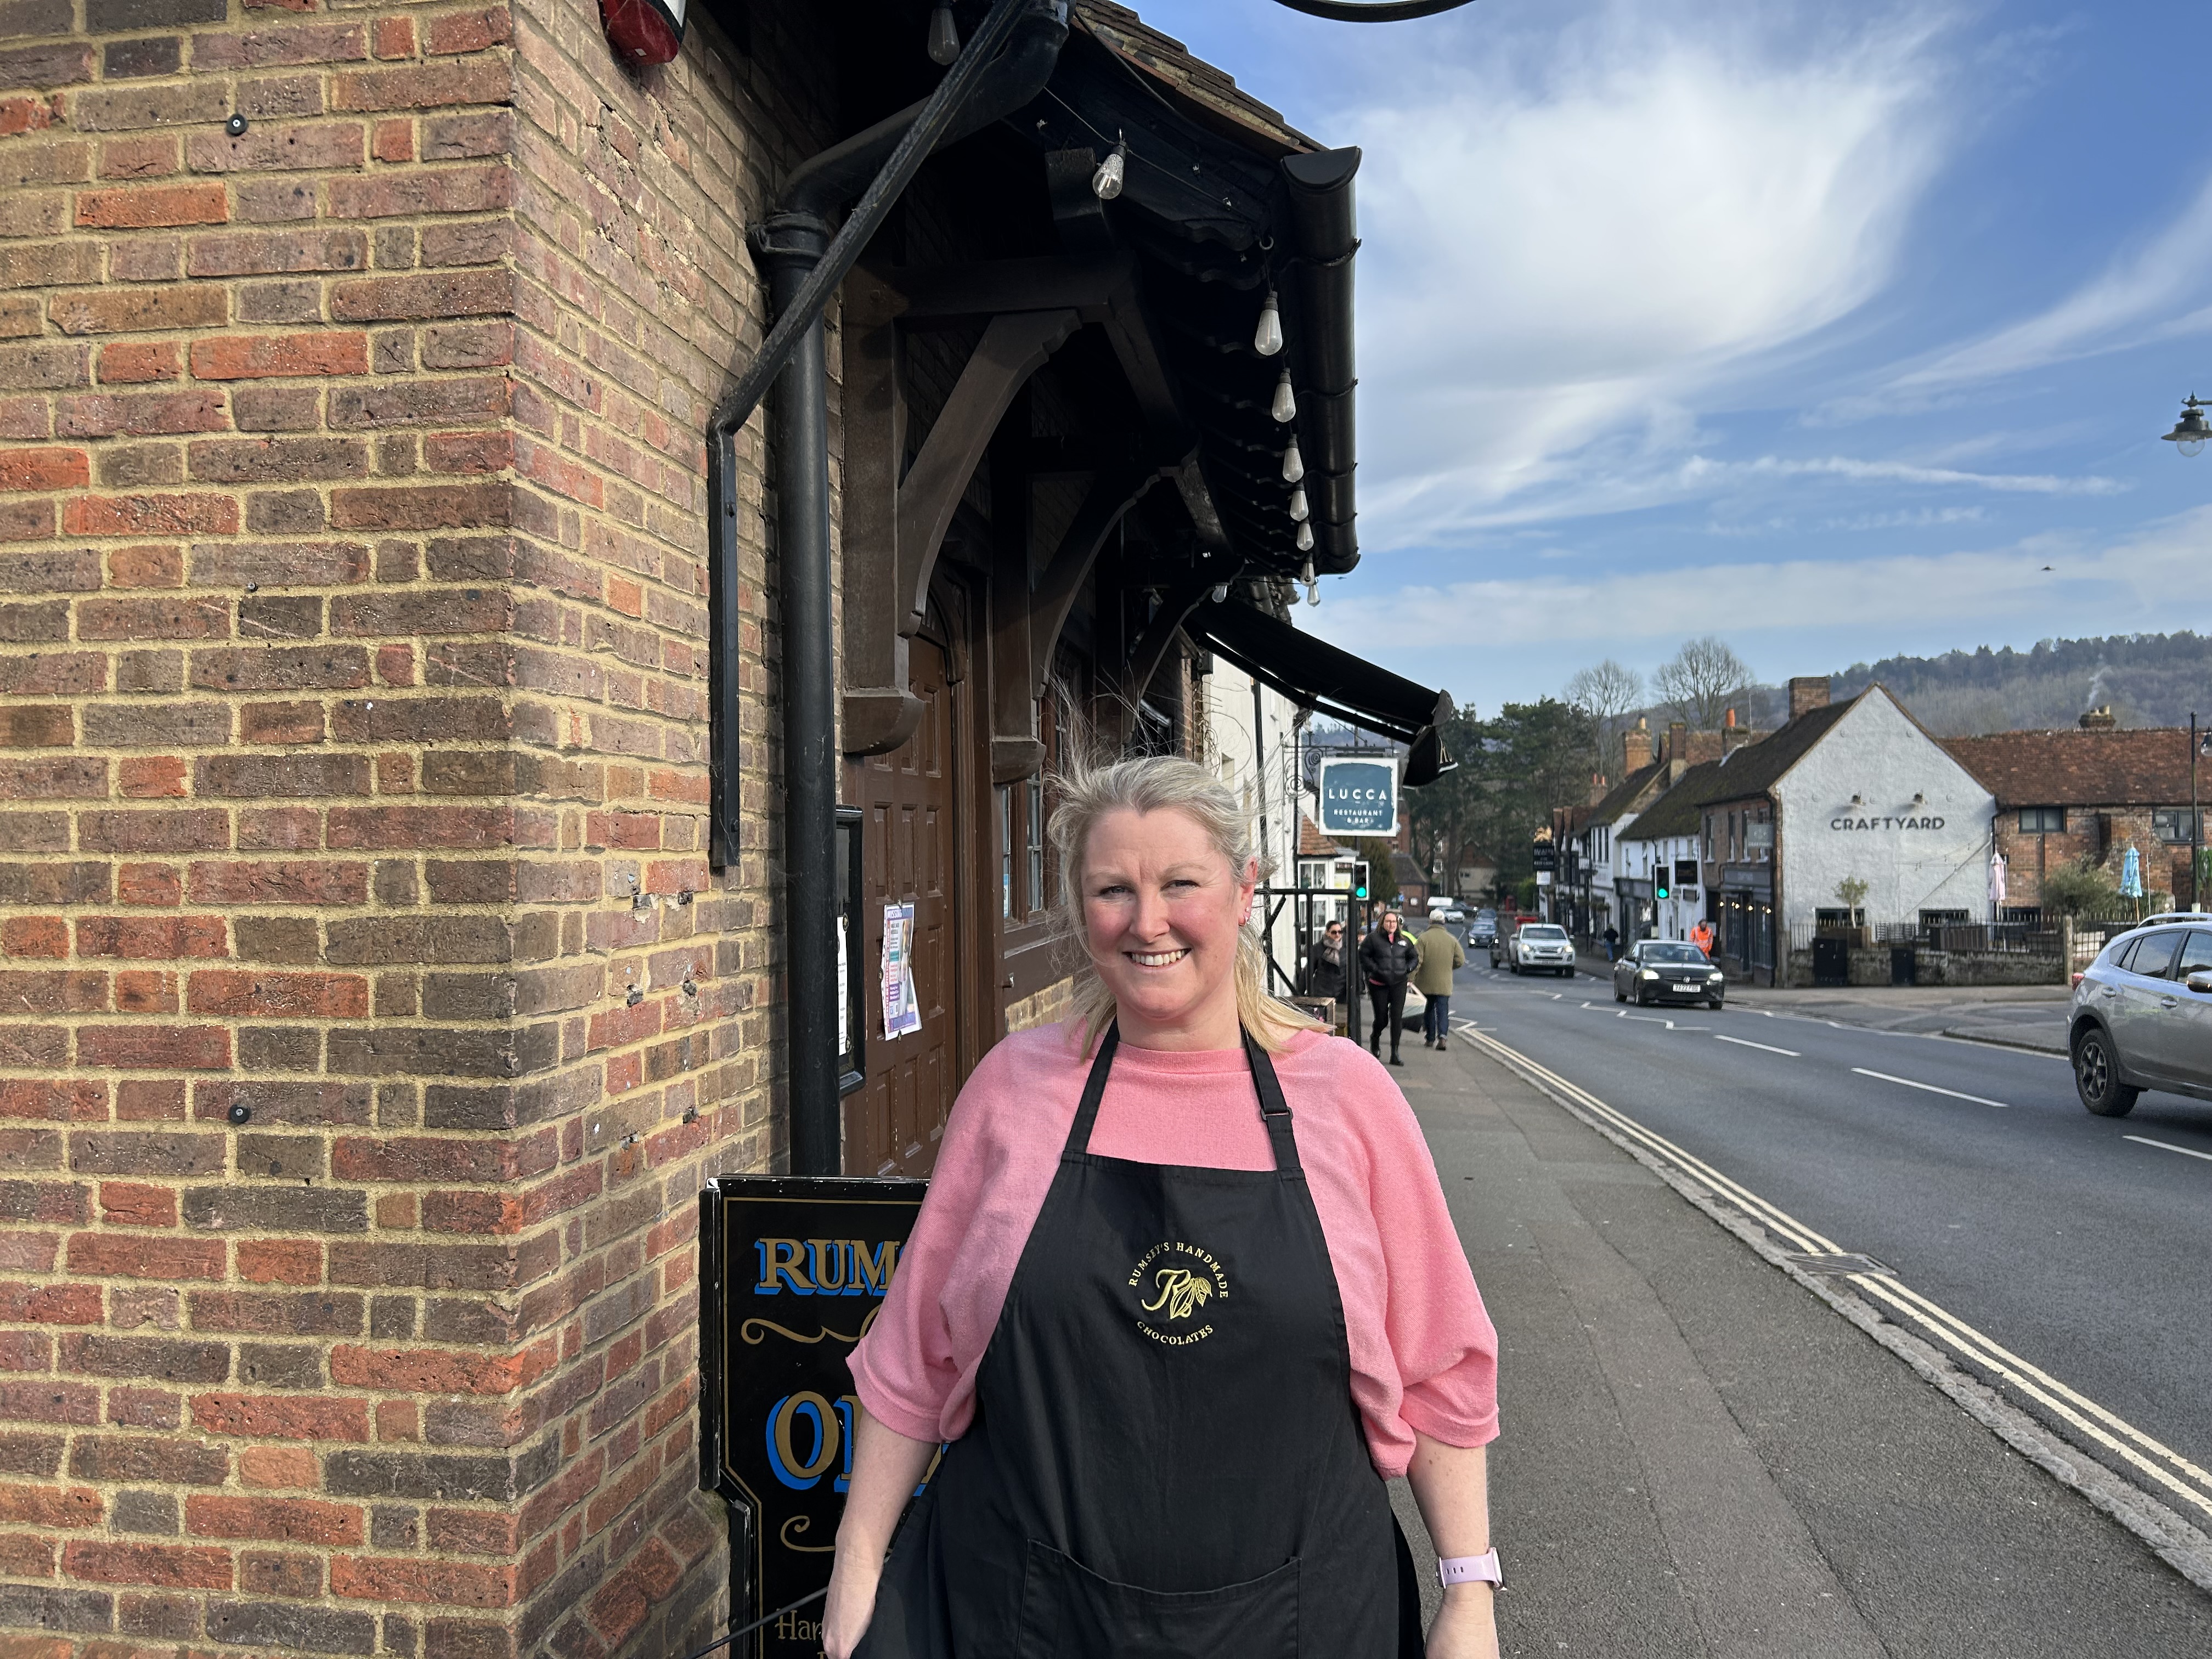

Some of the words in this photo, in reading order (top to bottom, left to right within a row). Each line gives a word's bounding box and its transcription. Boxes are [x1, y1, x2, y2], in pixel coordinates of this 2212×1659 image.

[1328, 788, 1386, 800] LUCCA
[1831, 816, 1945, 831] CRAFTYARD
[754, 1238, 904, 1296] RUM
[1128, 1242, 1170, 1286] RUMSEY'S
[1176, 1242, 1228, 1298] HANDMADE
[1137, 1321, 1213, 1345] CHOCOLATES
